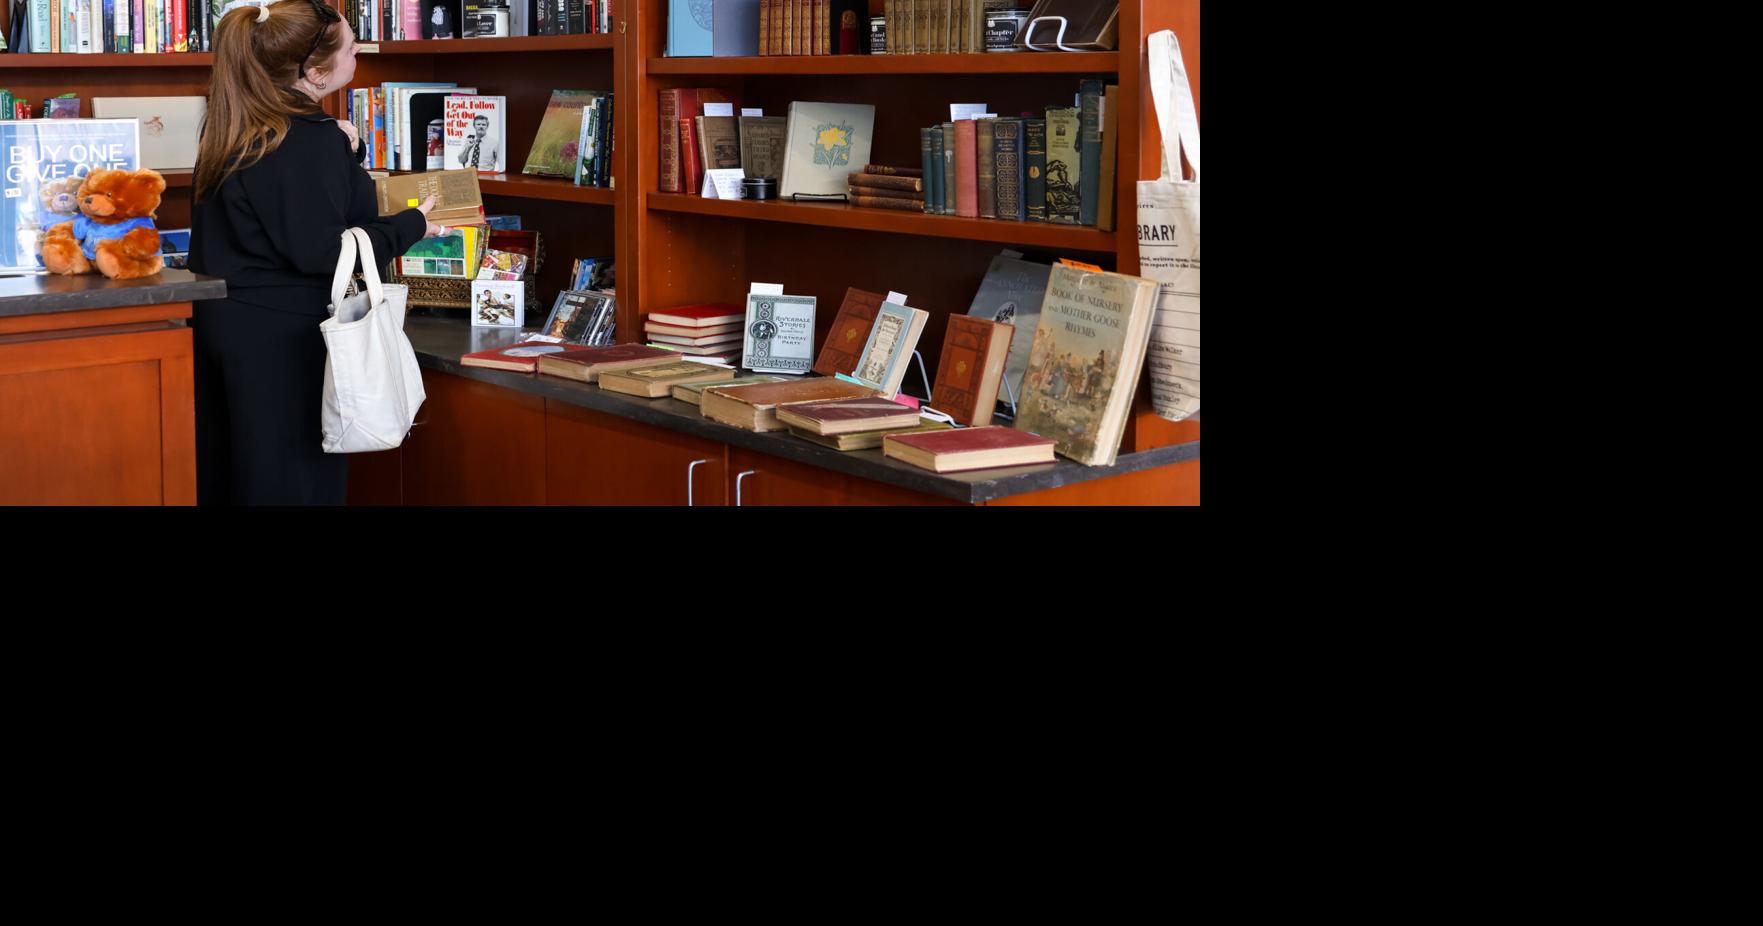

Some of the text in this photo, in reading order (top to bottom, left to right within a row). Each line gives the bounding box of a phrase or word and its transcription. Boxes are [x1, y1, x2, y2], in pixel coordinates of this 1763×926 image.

[470, 101, 495, 109] Follow
[447, 128, 463, 137] Way
[456, 120, 468, 128] the
[9, 143, 125, 164] BUY ONE
[6, 163, 66, 183] GVE
[1051, 287, 1124, 313] BOOK OF NURSERY
[1060, 304, 1092, 321] MOTHER
[1093, 314, 1121, 329] GOOSE
[1064, 320, 1096, 337] RHYMES
